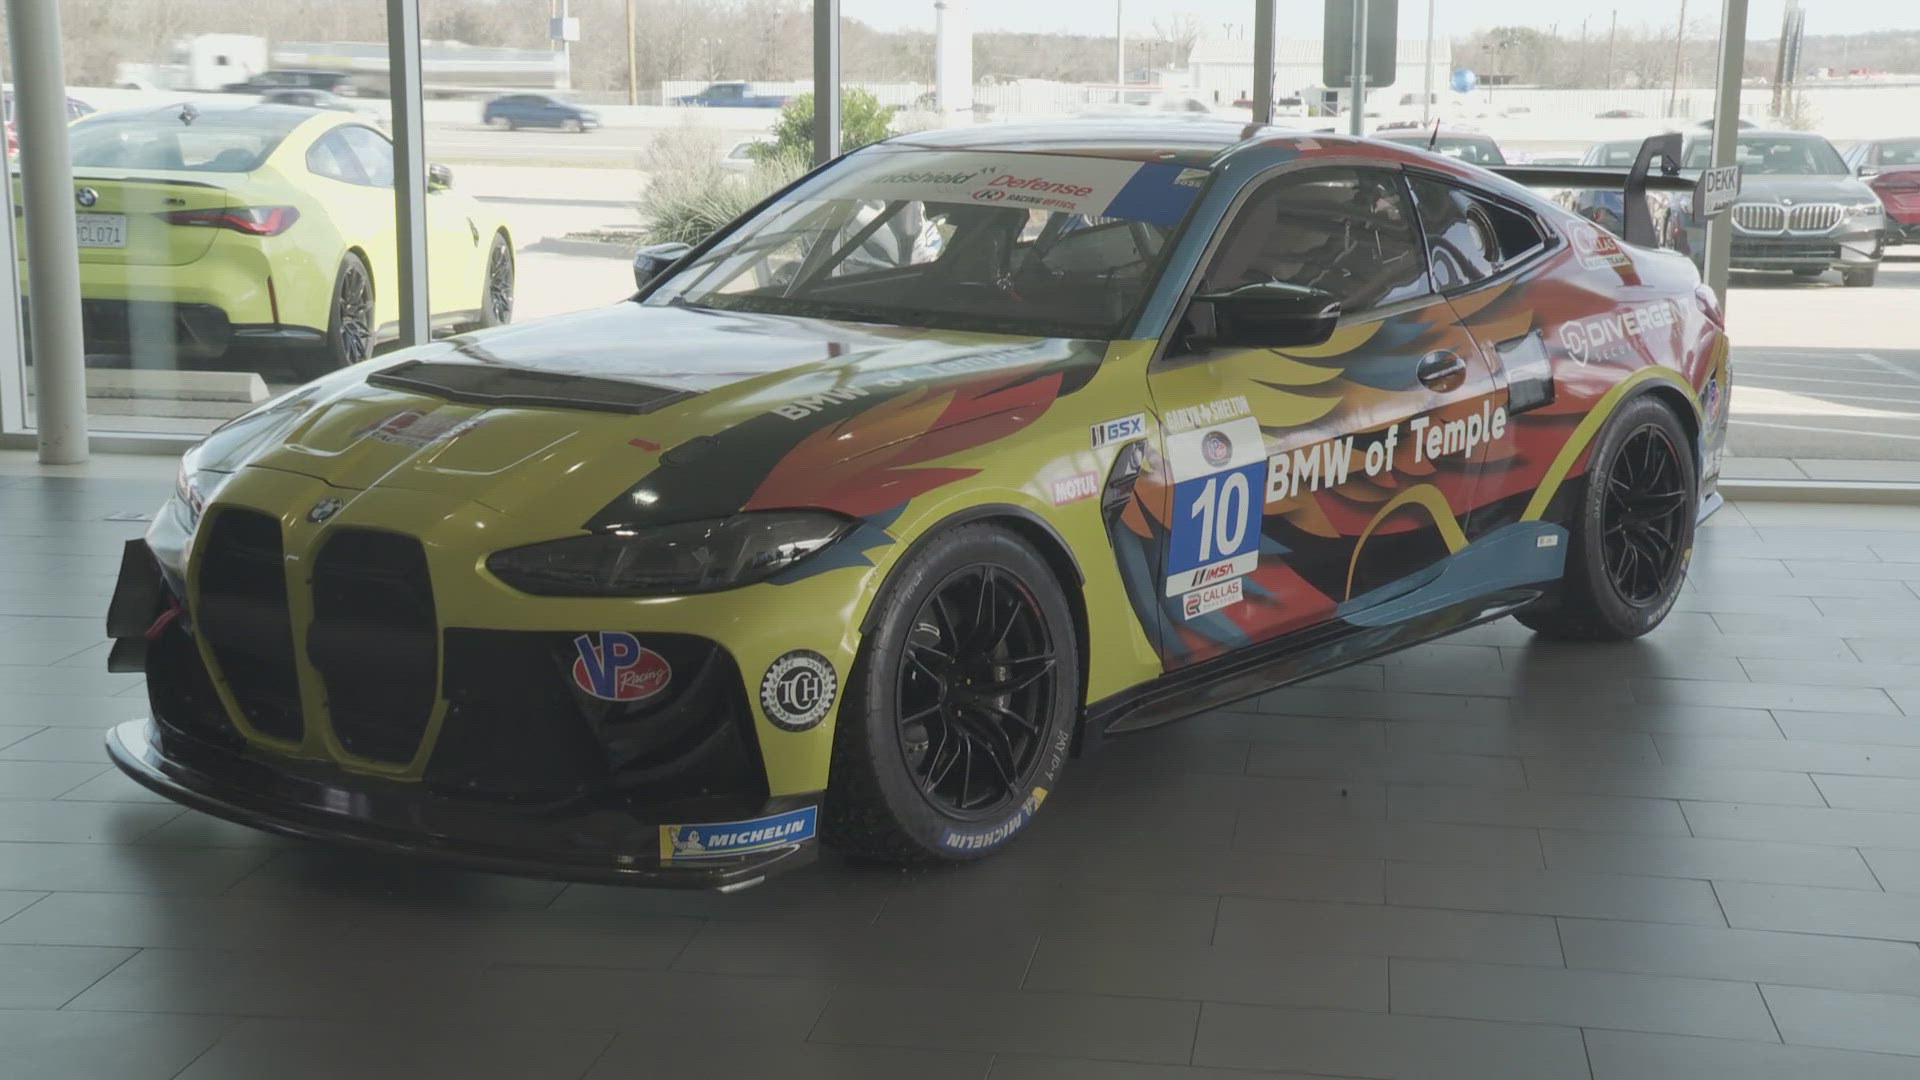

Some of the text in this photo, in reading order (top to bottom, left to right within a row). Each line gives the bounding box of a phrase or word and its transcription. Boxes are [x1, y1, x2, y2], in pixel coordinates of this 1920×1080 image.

[988, 174, 1093, 197] Defense
[1707, 167, 1736, 193] DEKK
[1006, 194, 1042, 205] RACING
[1042, 198, 1077, 210] OPTICS
[771, 383, 870, 420] BMW
[1210, 395, 1251, 421] SHELTON
[1107, 418, 1143, 440] GSX
[1266, 436, 1353, 504] BMW
[1365, 424, 1399, 477] of
[1411, 400, 1507, 464] Temple
[1054, 474, 1098, 502] MOTUL
[1191, 471, 1250, 562] 10
[1204, 563, 1235, 581] IMSA
[1203, 581, 1239, 603] CALLAS
[574, 631, 641, 701] VP
[620, 666, 669, 691] Racing
[708, 819, 806, 847] MICHELIN
[946, 812, 1022, 849] MICHELIN
